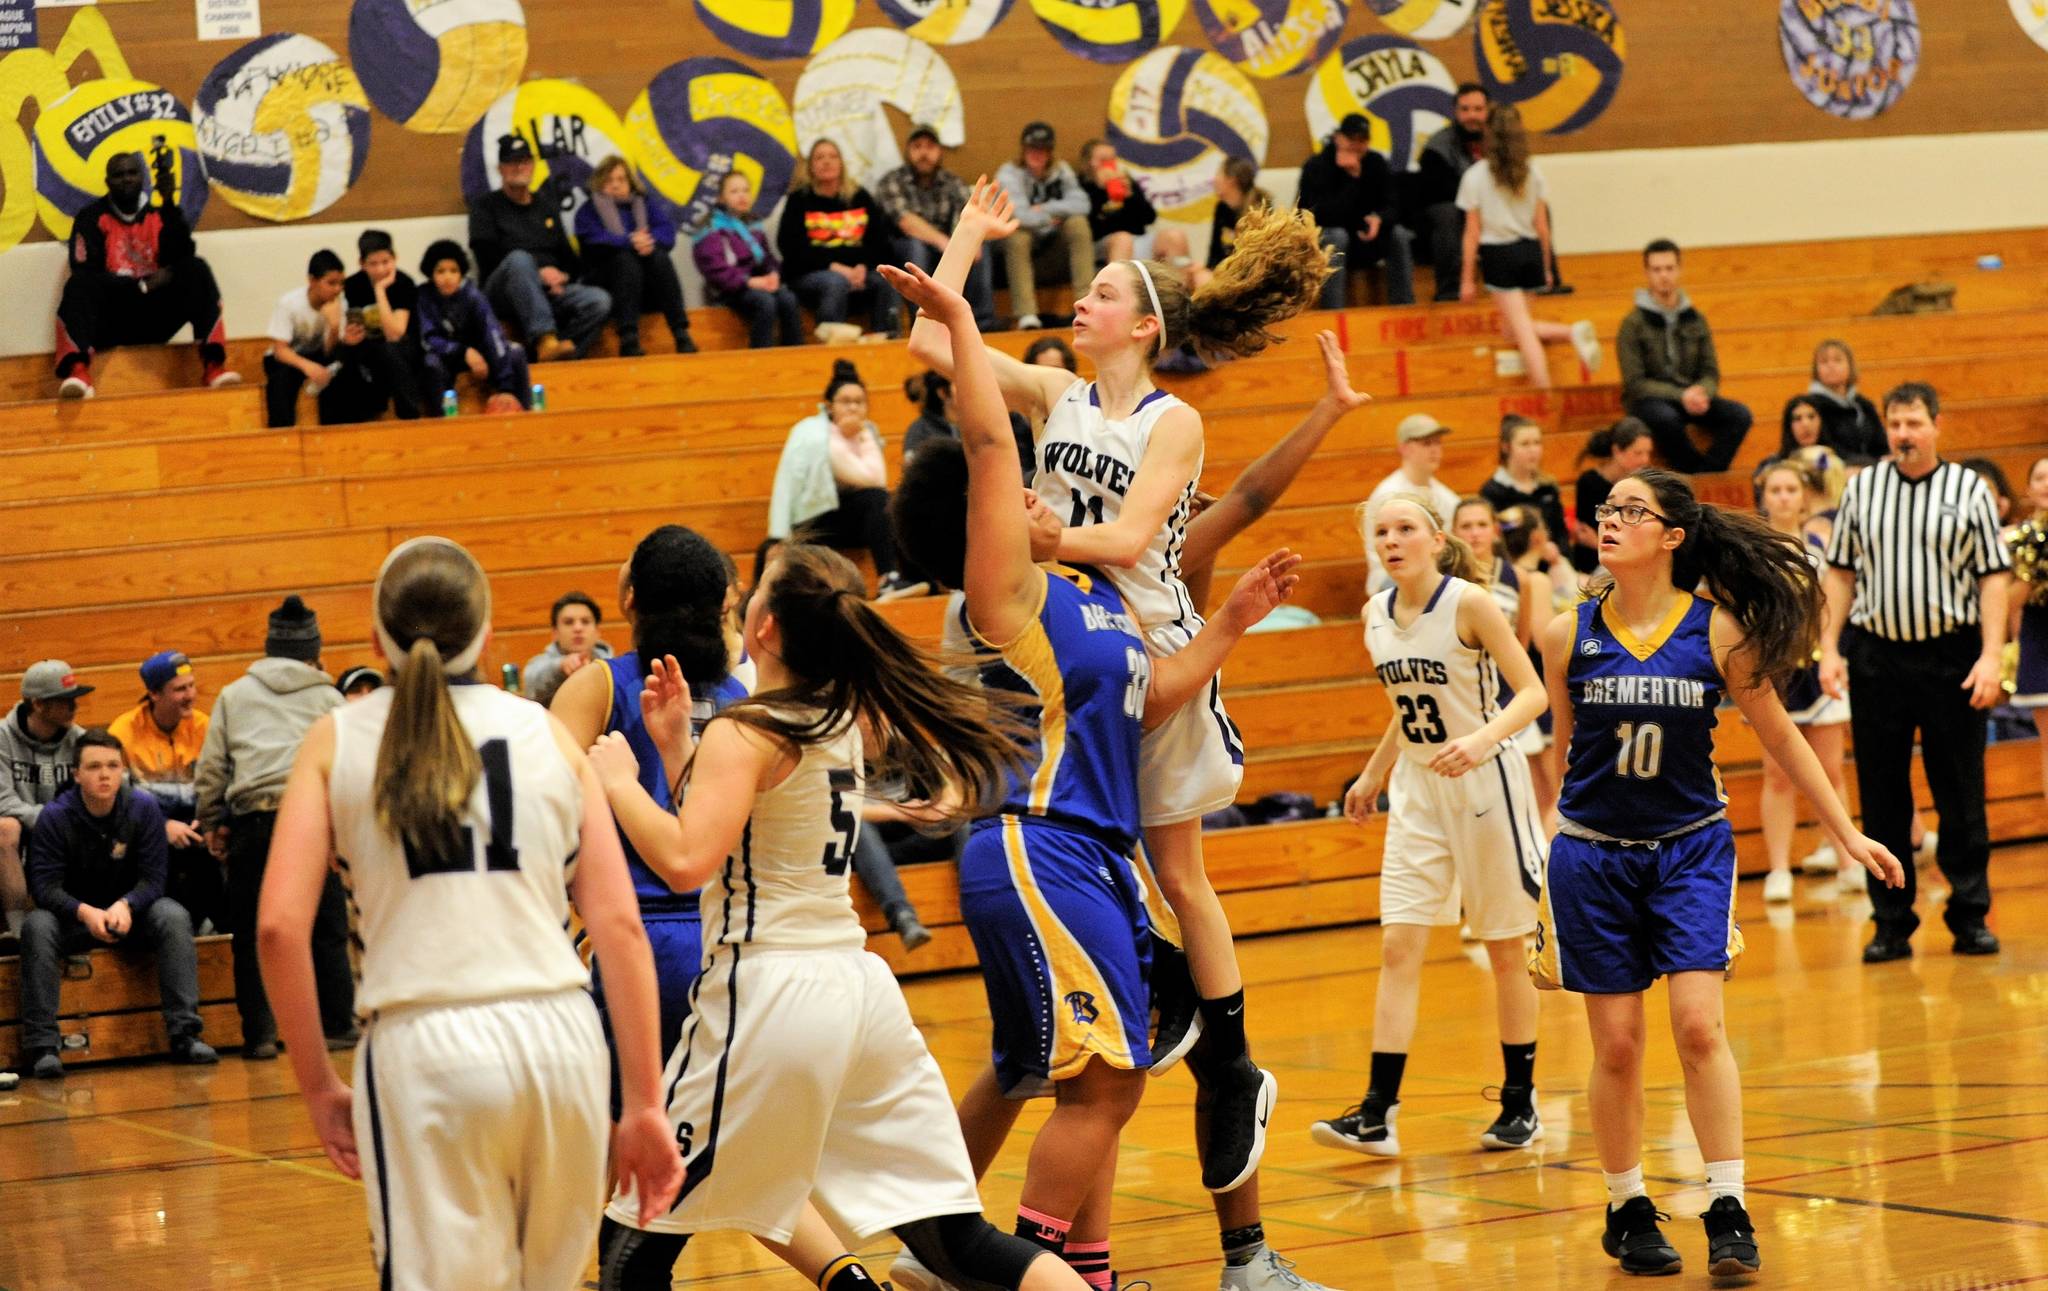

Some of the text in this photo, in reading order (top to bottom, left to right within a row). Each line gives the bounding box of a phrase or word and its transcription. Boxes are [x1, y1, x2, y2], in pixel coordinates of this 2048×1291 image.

[1348, 48, 1427, 99] JAYLA
[516, 113, 588, 160] LAR
[1583, 674, 1705, 708] BREMERTON
[1396, 694, 1447, 744] 23
[1615, 721, 1664, 780] 10
[401, 739, 521, 880] 1
[822, 768, 857, 877] 5
[1063, 991, 1099, 1026] B
[676, 1121, 694, 1158] S
